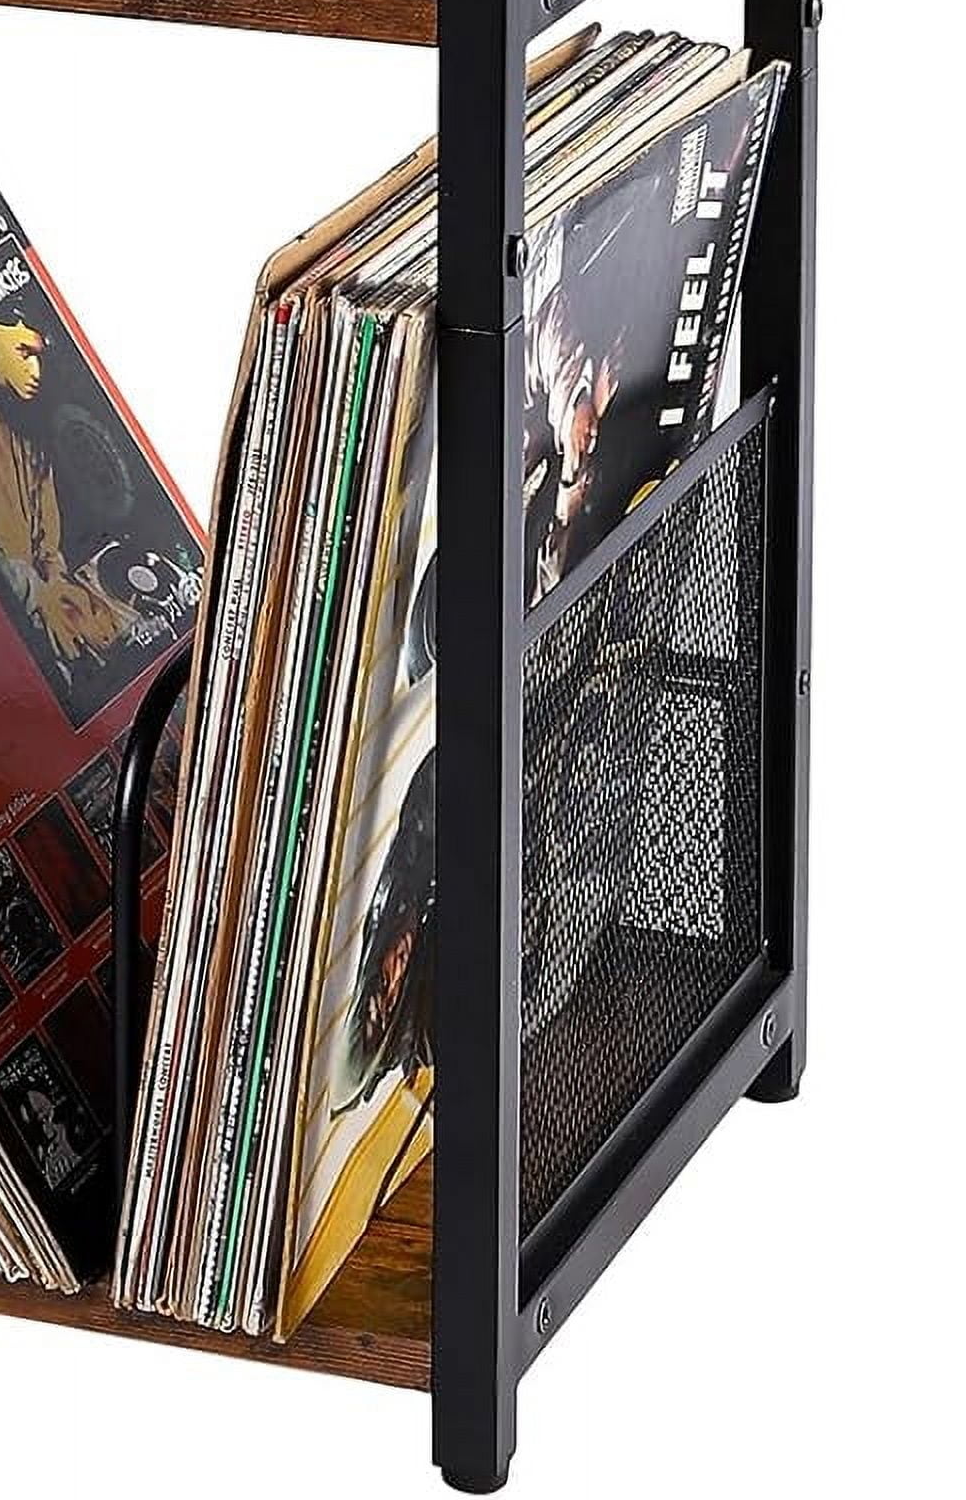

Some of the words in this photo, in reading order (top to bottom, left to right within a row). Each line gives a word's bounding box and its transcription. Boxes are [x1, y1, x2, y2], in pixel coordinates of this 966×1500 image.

[696, 161, 732, 219] IT
[667, 243, 715, 383] FEEL
[659, 407, 685, 427] I
